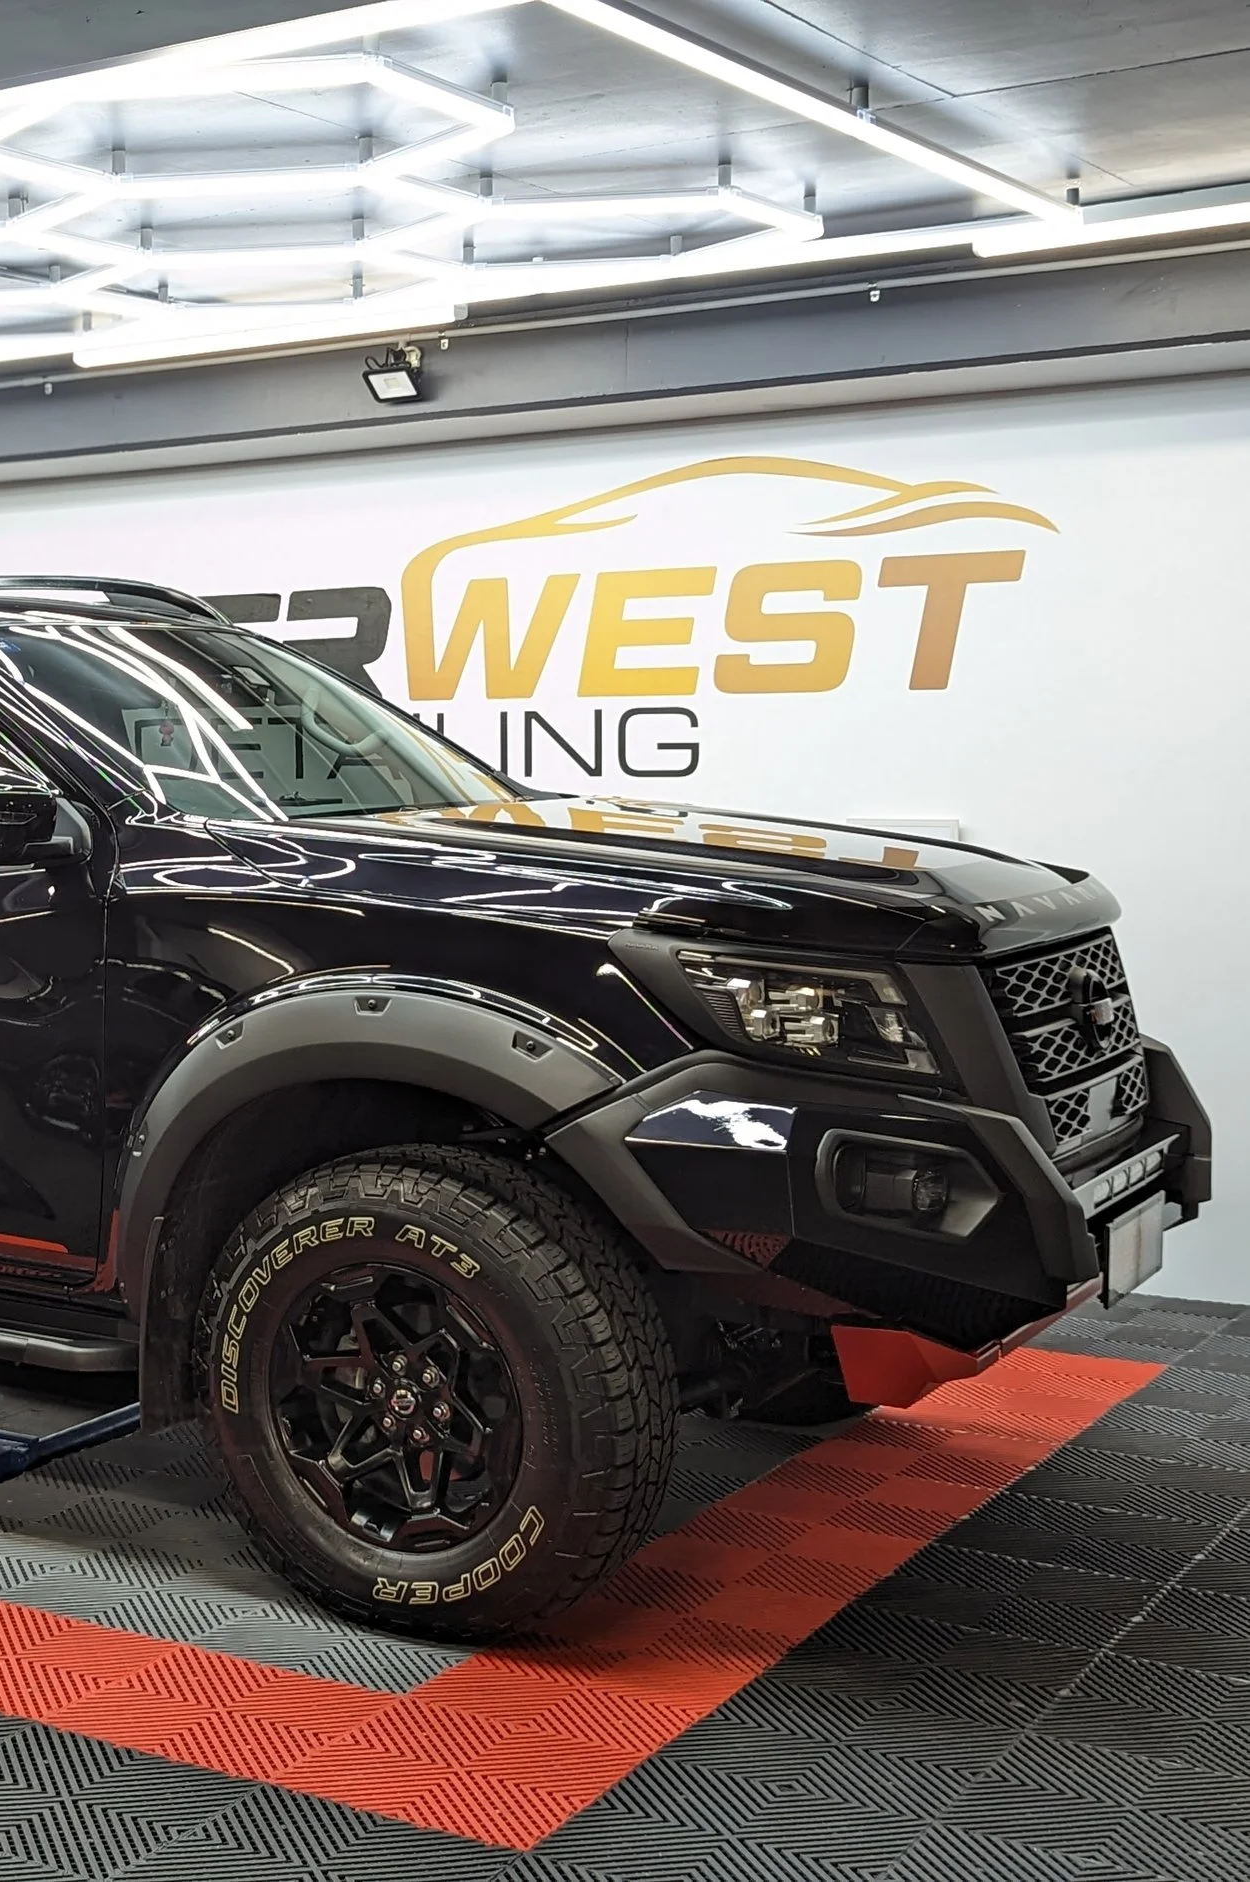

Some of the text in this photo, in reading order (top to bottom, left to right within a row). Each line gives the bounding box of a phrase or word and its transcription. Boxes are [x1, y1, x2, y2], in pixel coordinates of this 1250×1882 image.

[221, 1216, 376, 1415] DISCOVERER
[395, 1223, 481, 1279] AT3
[372, 1505, 545, 1605] COOPER
